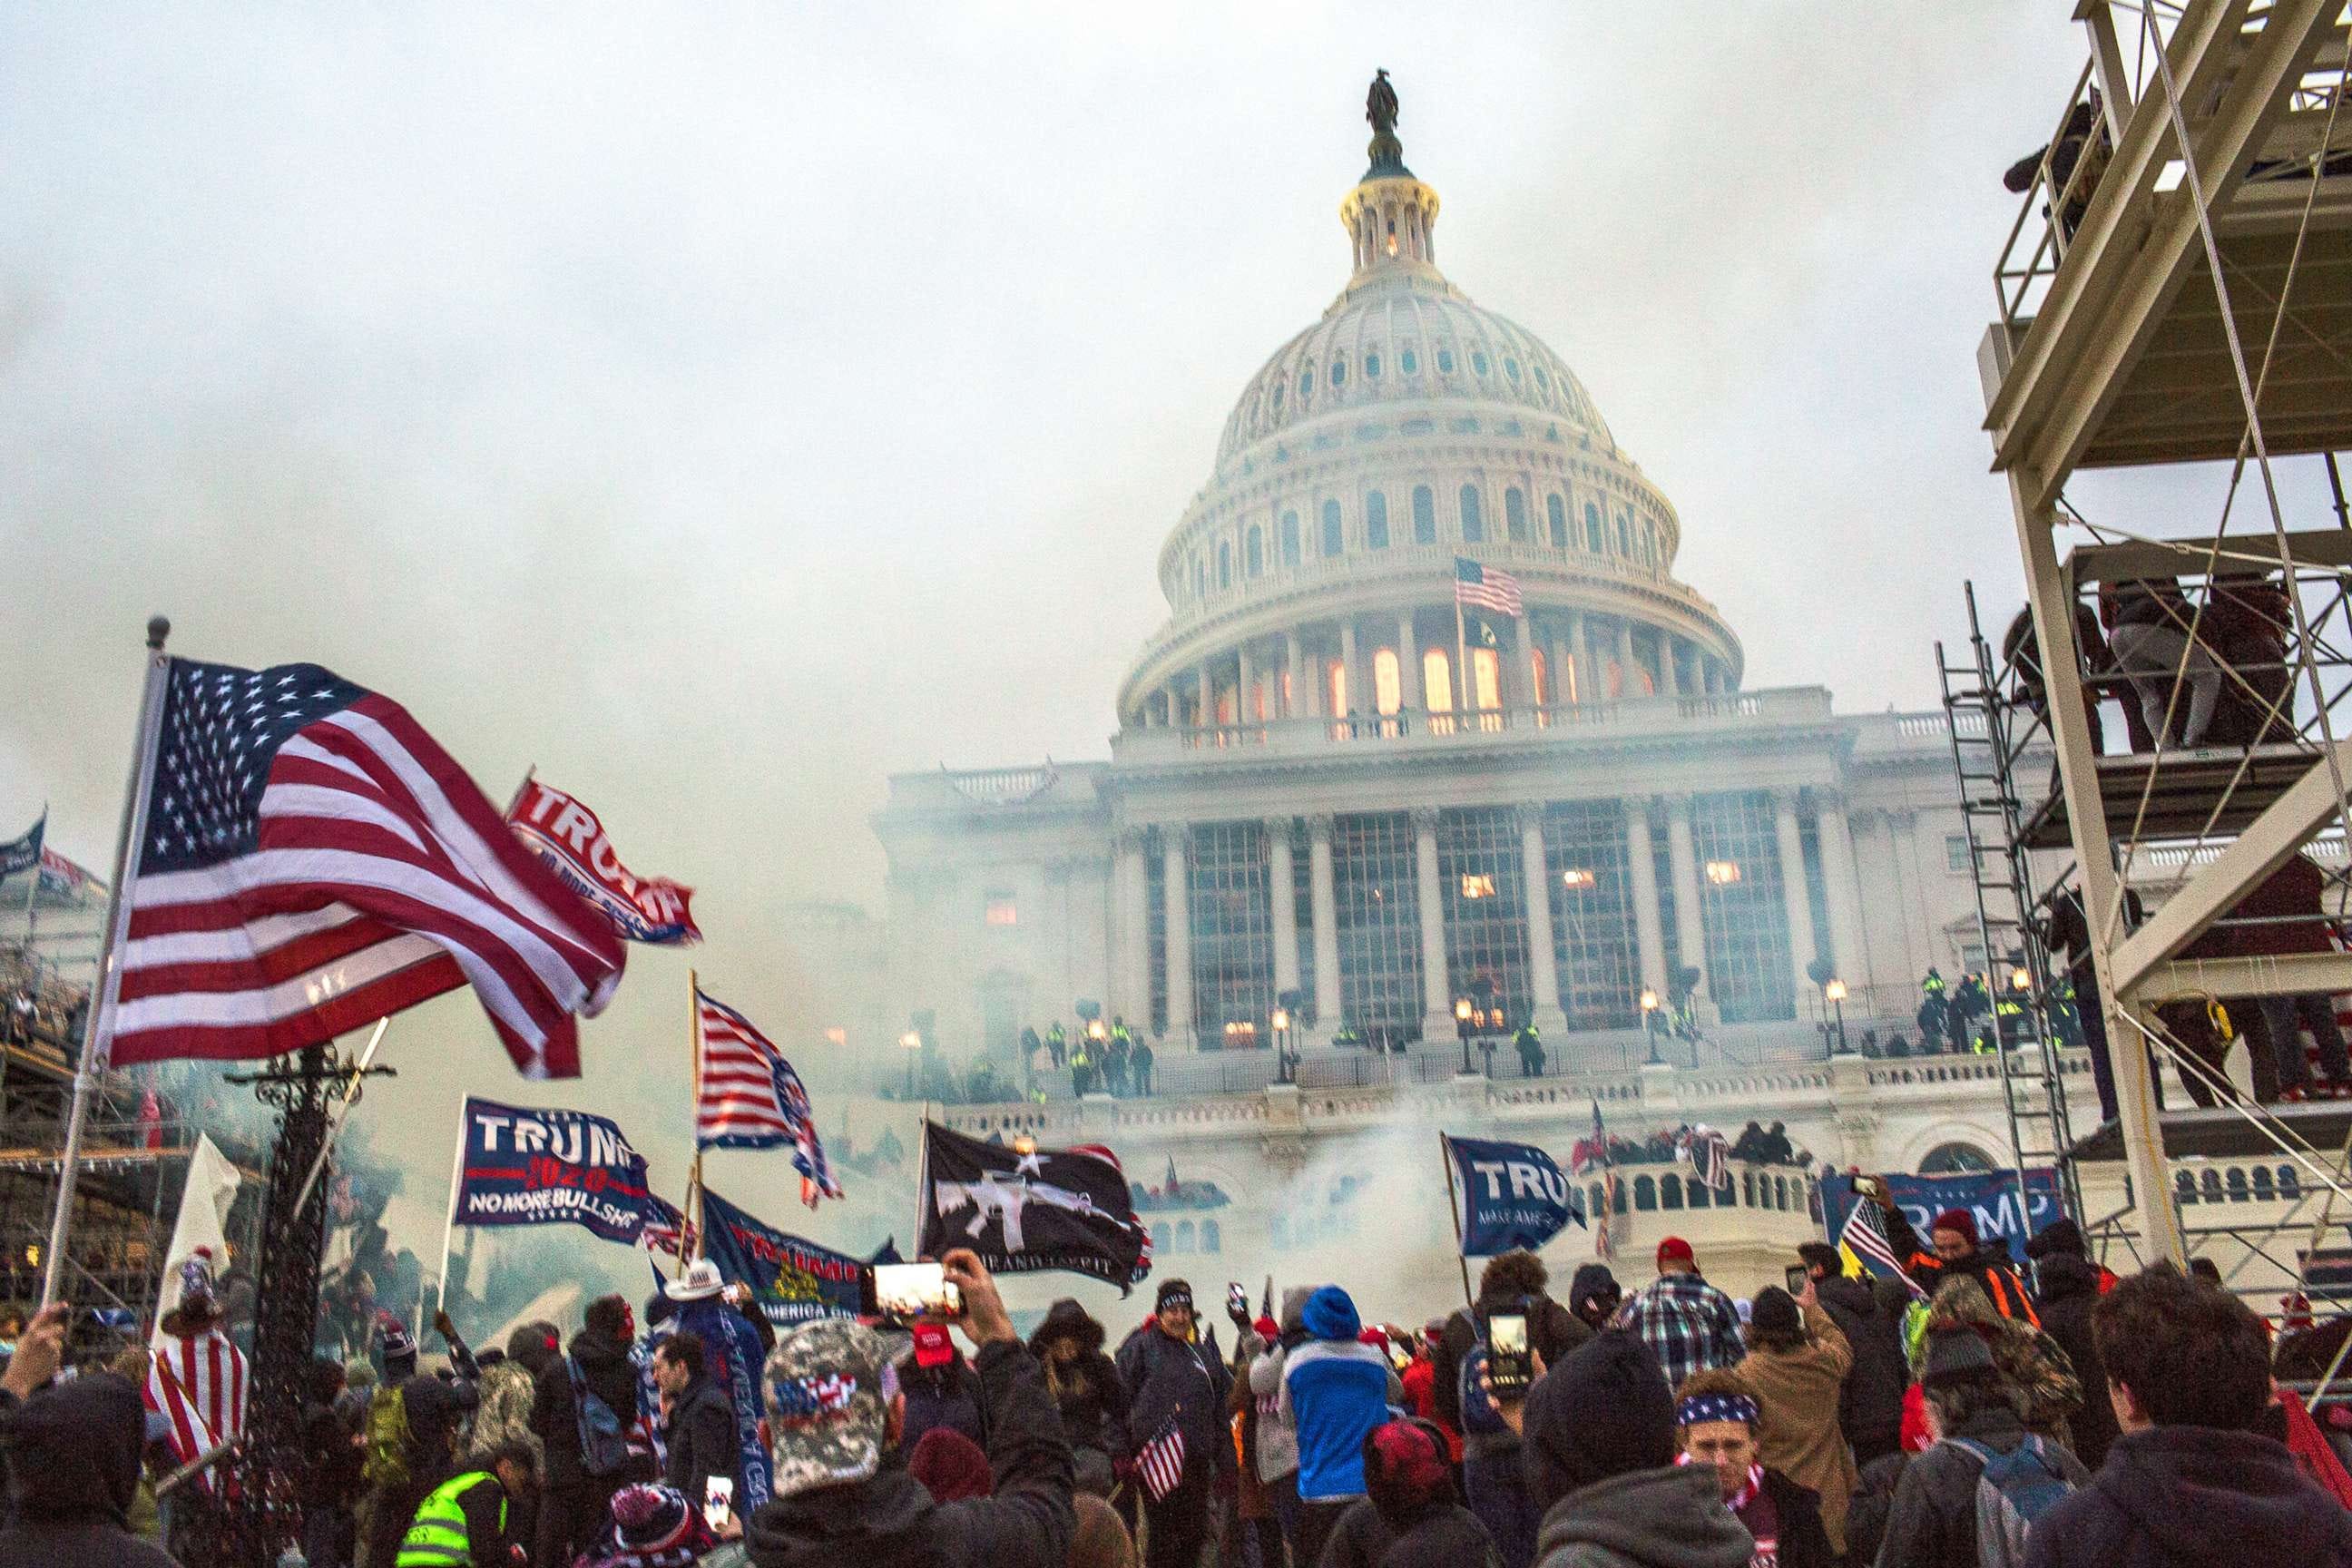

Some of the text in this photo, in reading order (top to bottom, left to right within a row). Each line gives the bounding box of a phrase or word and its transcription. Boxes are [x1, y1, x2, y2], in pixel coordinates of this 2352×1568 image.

[469, 1188, 639, 1229] NO MORE BULLSHIT
[758, 1302, 826, 1320] AMERICA
